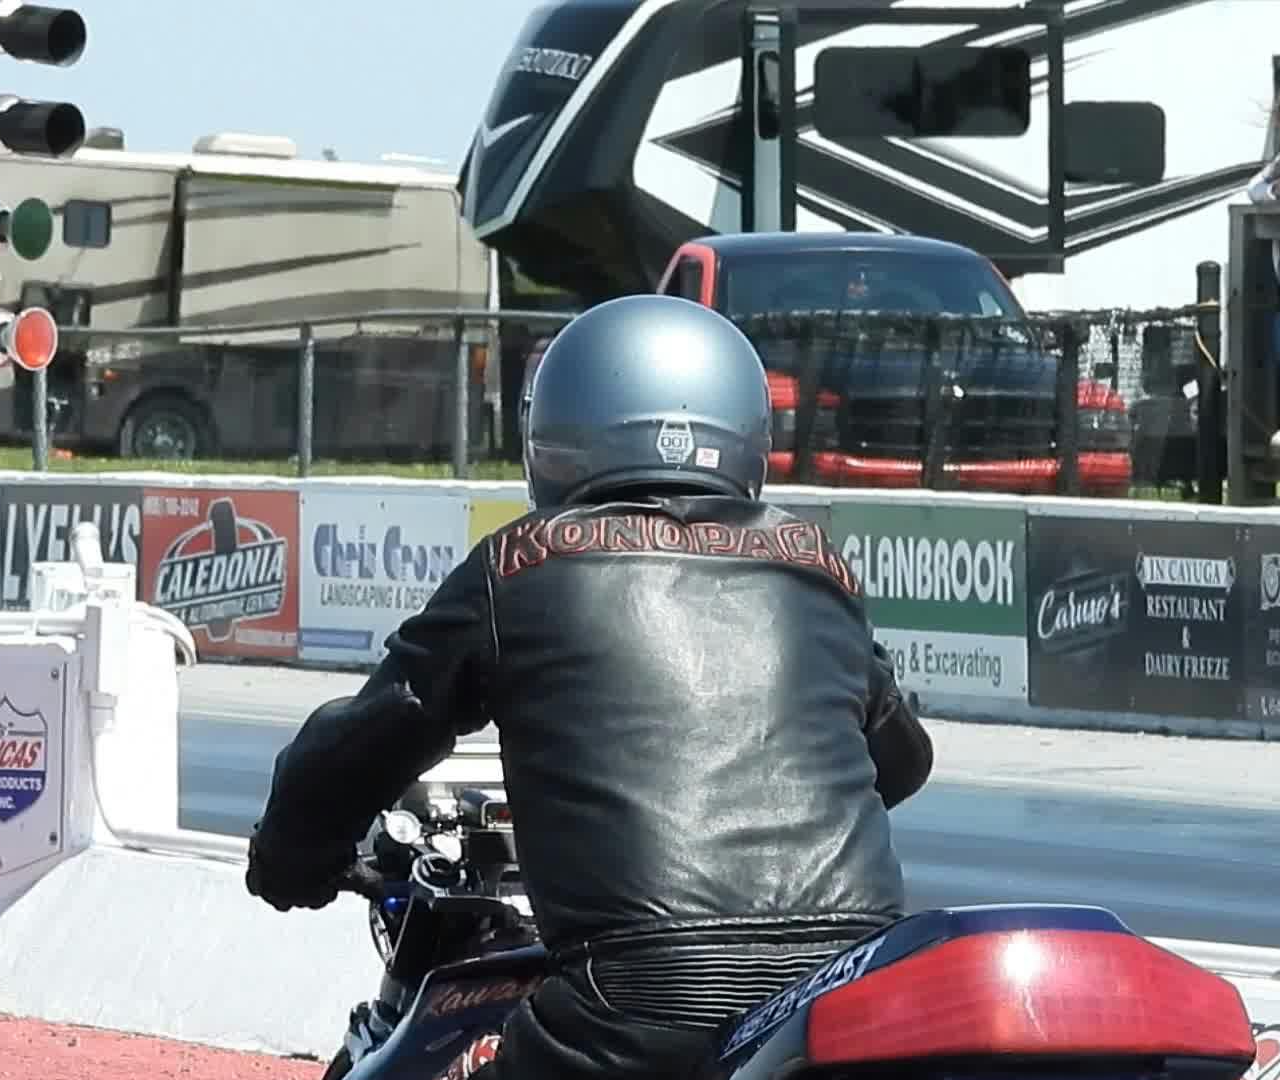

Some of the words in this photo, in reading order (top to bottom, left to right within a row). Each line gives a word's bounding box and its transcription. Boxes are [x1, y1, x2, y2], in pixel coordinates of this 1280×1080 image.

[155, 544, 286, 605] CALEDONIA
[842, 533, 1015, 606] GLANBROOK
[1150, 559, 1165, 582] IN
[1167, 558, 1222, 585] CAYUGA
[1037, 583, 1125, 640] Caruso's
[1146, 593, 1227, 622] RESTAURANT
[1181, 625, 1191, 649] &
[908, 641, 921, 671] &
[924, 643, 1004, 689] Excavating
[1144, 652, 1181, 678] DAIRY
[1183, 654, 1232, 682] FREEZE
